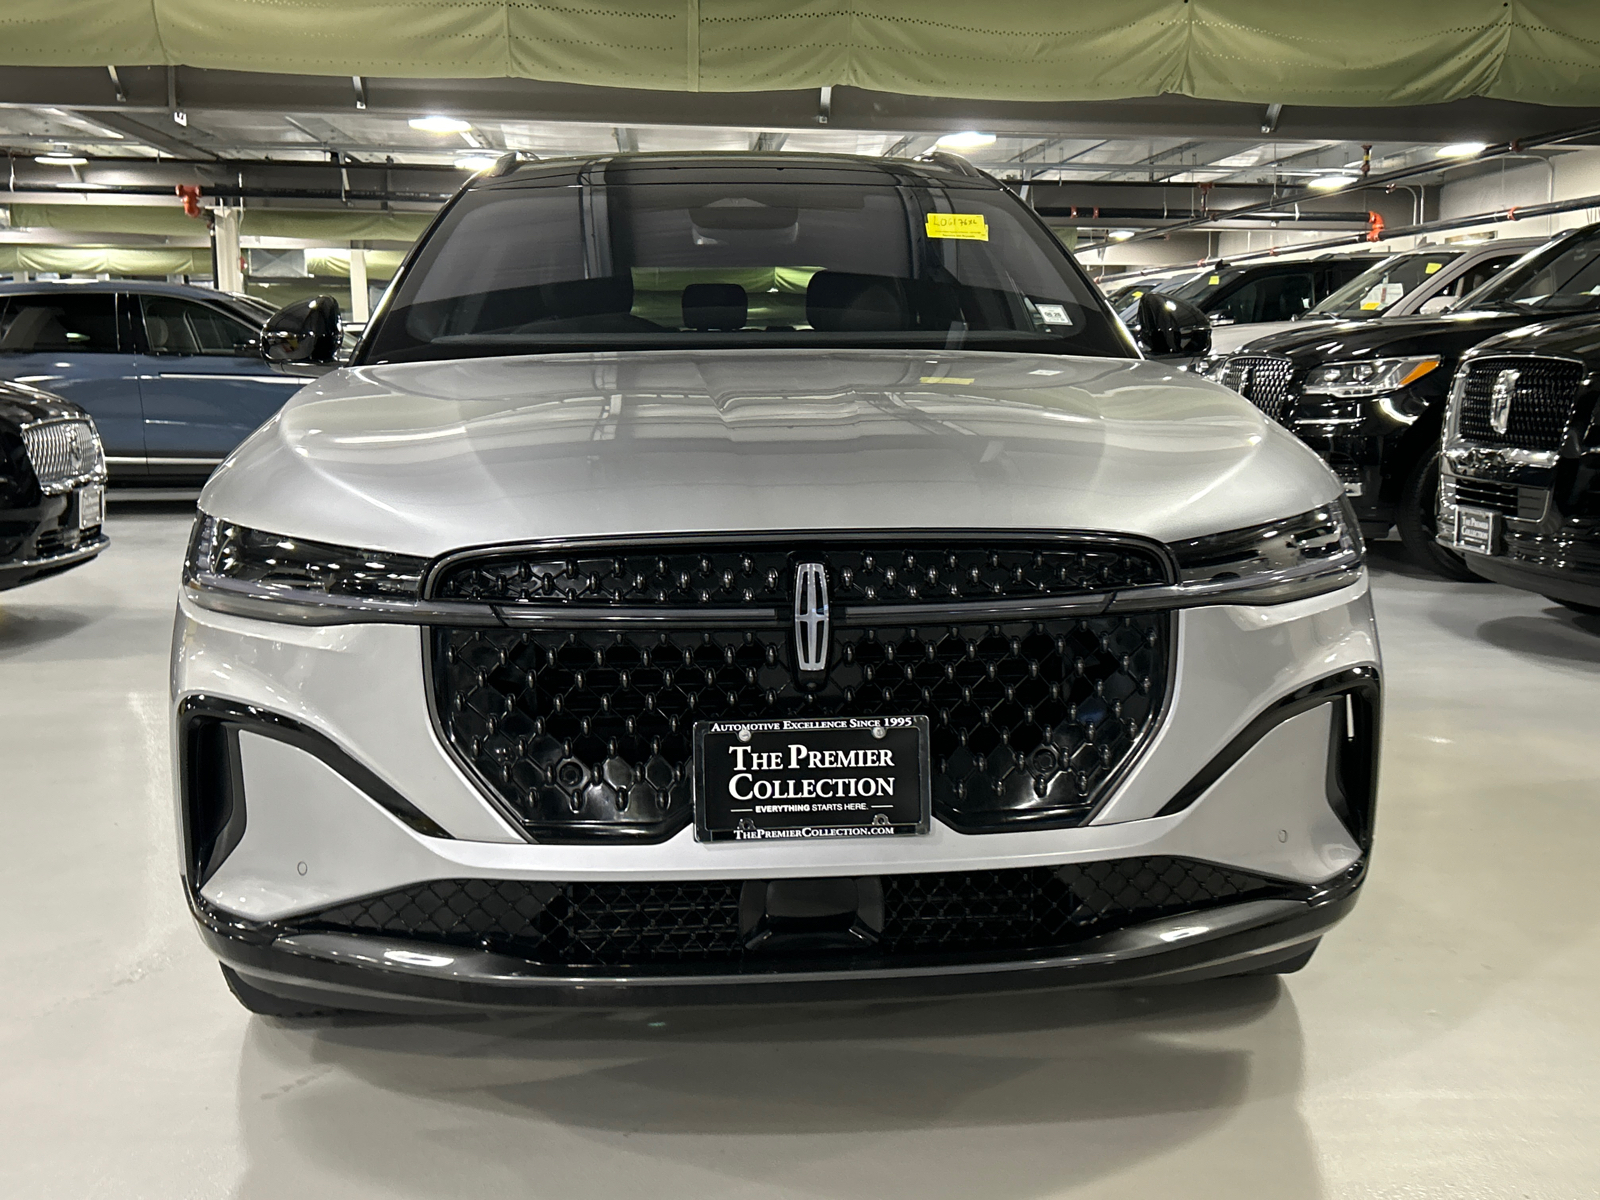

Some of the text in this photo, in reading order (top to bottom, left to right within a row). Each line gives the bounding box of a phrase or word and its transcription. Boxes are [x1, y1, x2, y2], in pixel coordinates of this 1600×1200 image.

[711, 717, 912, 732] AUTOMOTIVE EXCELLENCE SINCE 1995
[729, 744, 895, 771] THE PREMIER
[728, 773, 895, 800] COLLECTION
[755, 803, 869, 813] EVERYTHING STARTS HERE.
[733, 827, 894, 840] THEPREMIERCOLLECTION.COM
